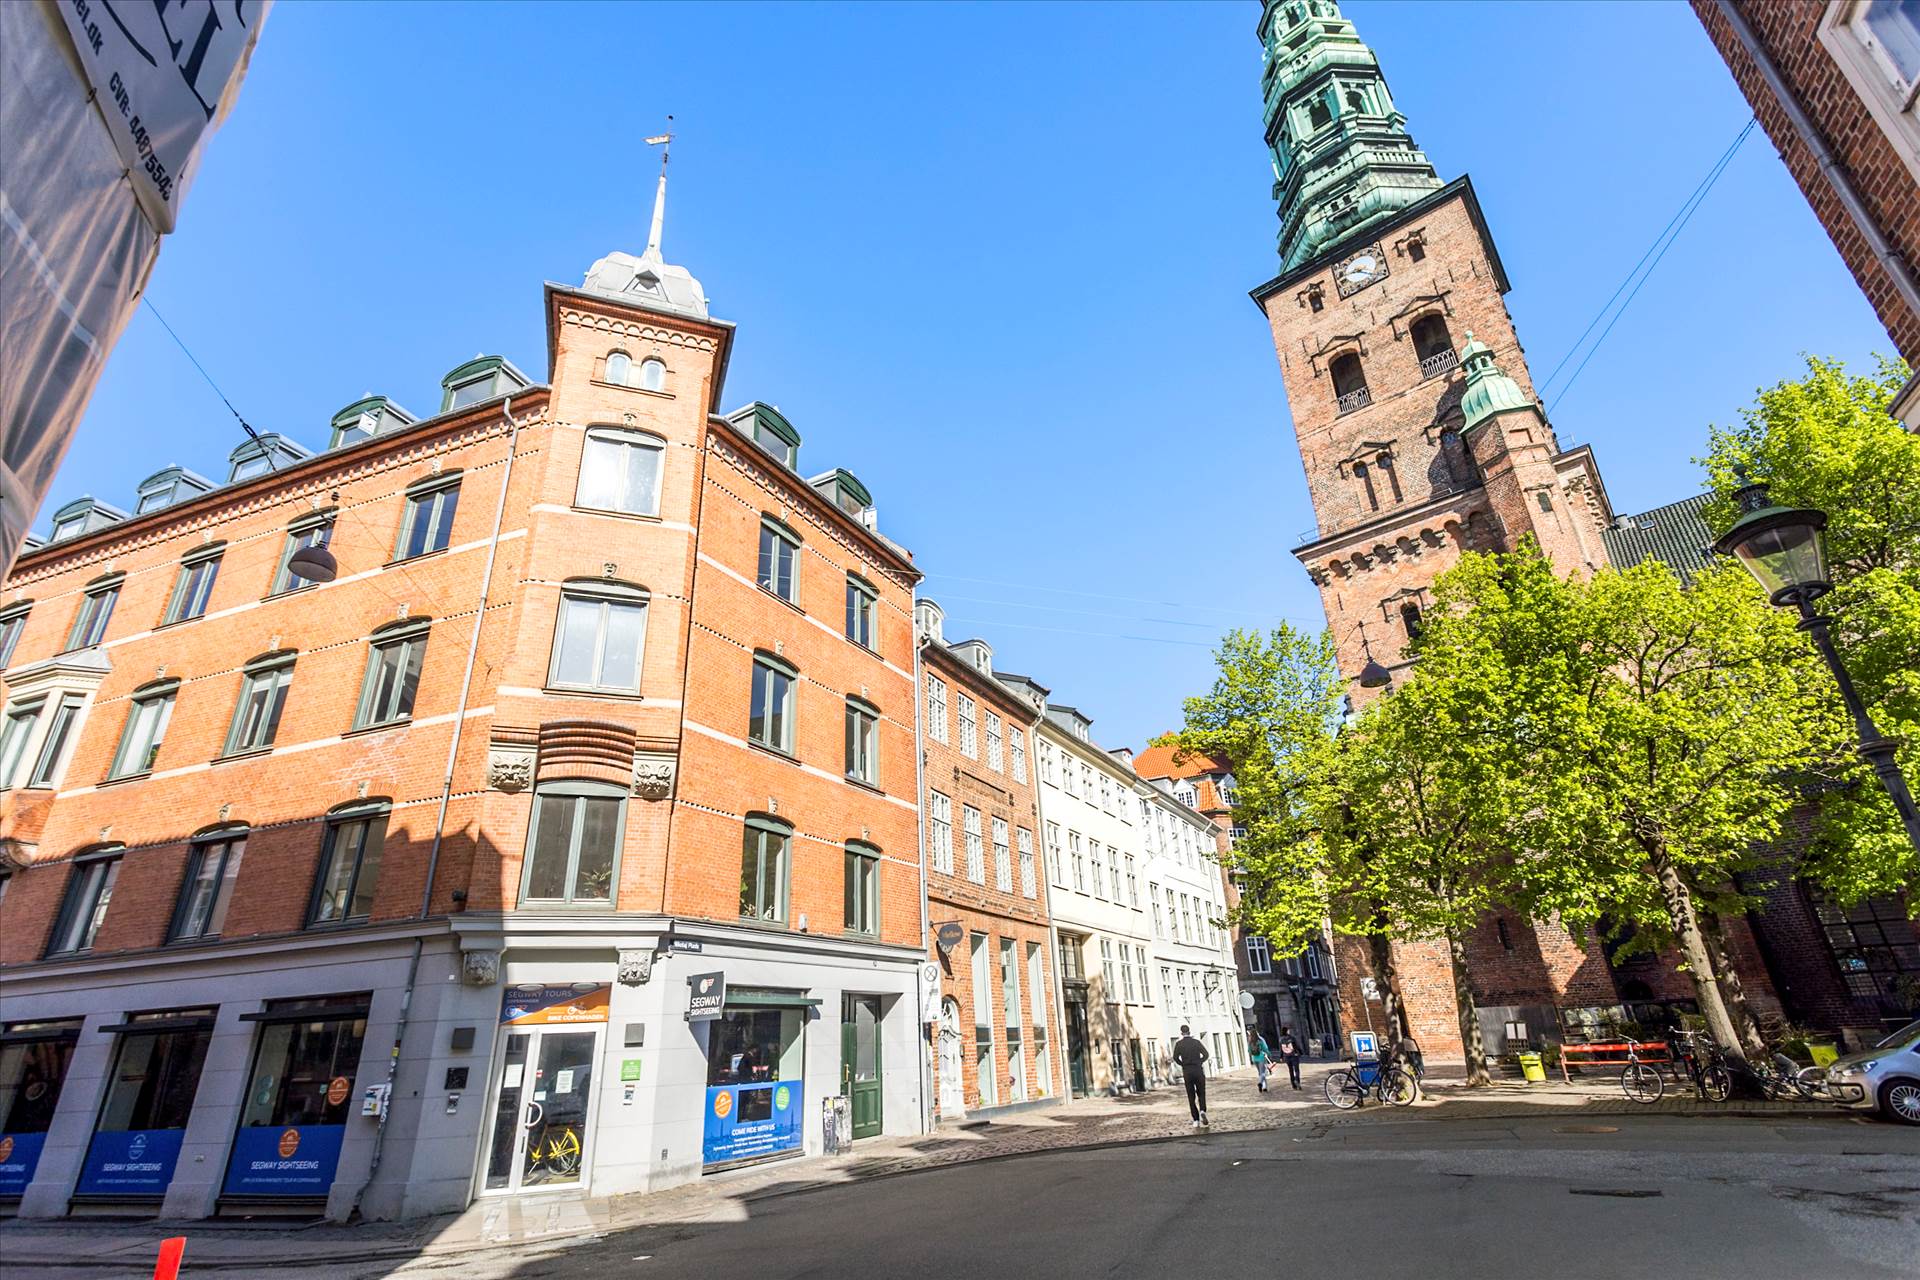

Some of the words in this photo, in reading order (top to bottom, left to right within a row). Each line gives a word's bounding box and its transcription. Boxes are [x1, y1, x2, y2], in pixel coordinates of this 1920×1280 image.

[109, 71, 131, 118] CVR:
[545, 990, 573, 998] TOURS
[691, 995, 721, 1008] SEGWAY
[250, 1161, 278, 1170] SEGWAY
[277, 1160, 320, 1170] SIGHTSEEING
